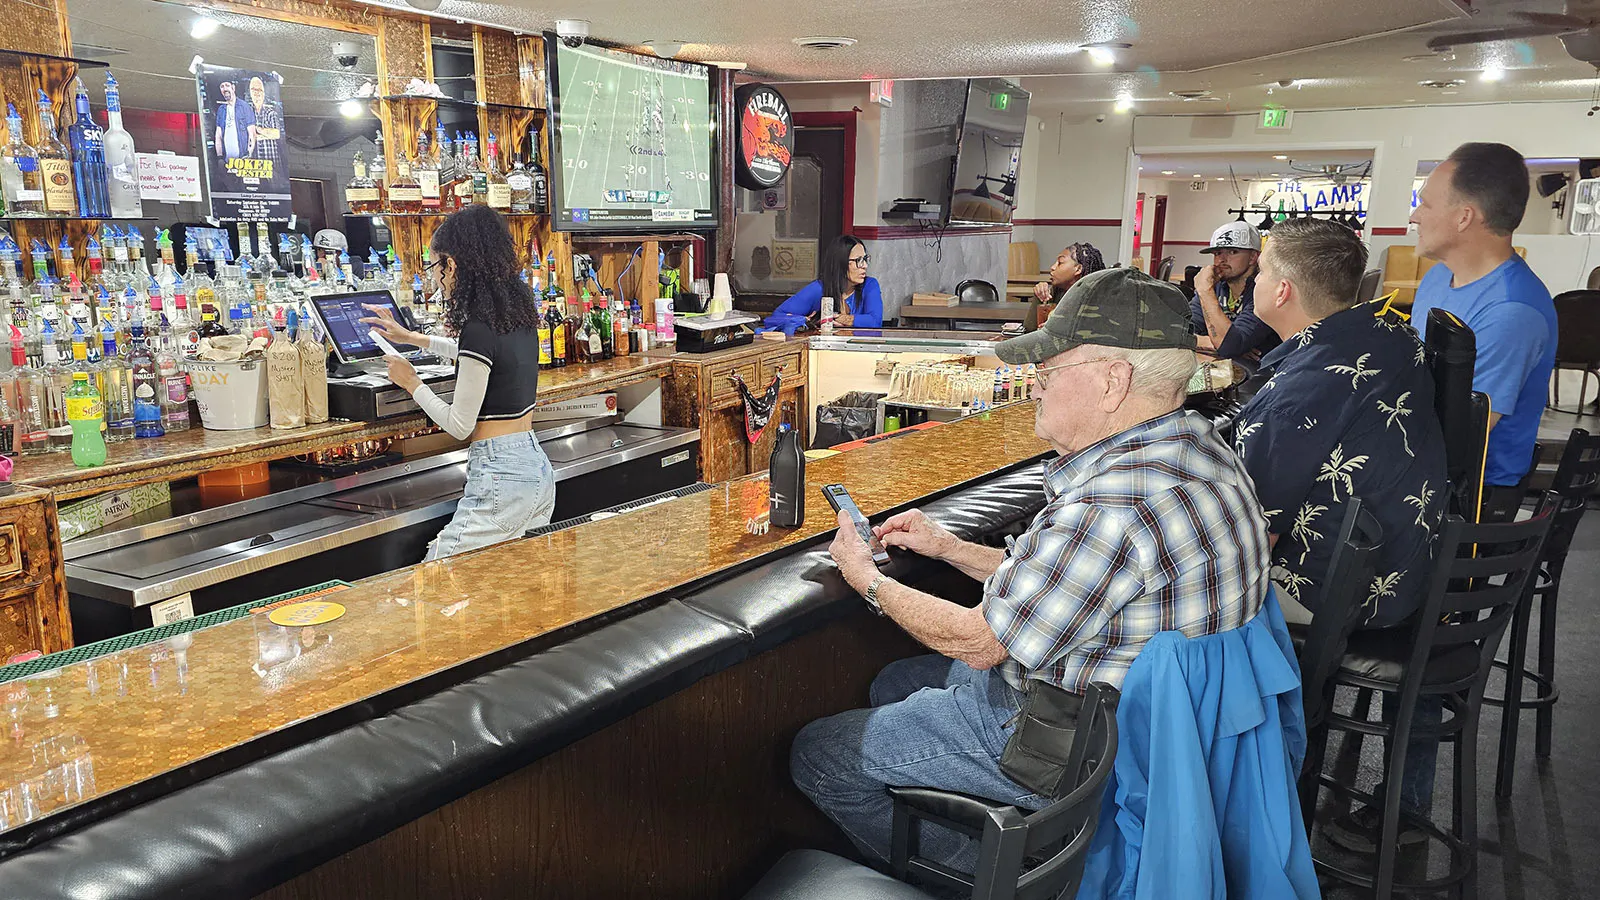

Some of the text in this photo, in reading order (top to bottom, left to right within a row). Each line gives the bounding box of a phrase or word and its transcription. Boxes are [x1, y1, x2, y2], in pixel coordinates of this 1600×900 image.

[748, 93, 788, 124] FIREBALL
[638, 147, 652, 155] 2nd
[139, 157, 152, 169] For
[155, 161, 167, 169] ALL
[225, 158, 273, 171] JOKER
[236, 169, 273, 179] JESTER
[1193, 181, 1205, 190] EXIT
[1277, 182, 1302, 193] THE
[1304, 182, 1363, 211] LAMP
[713, 334, 729, 345] Tito's
[58, 350, 72, 360] UV
[87, 348, 101, 359] UV
[198, 371, 229, 385] DAY
[275, 374, 295, 383] SHOT
[82, 402, 103, 416] Squirt
[104, 500, 130, 516] PATRÓN
